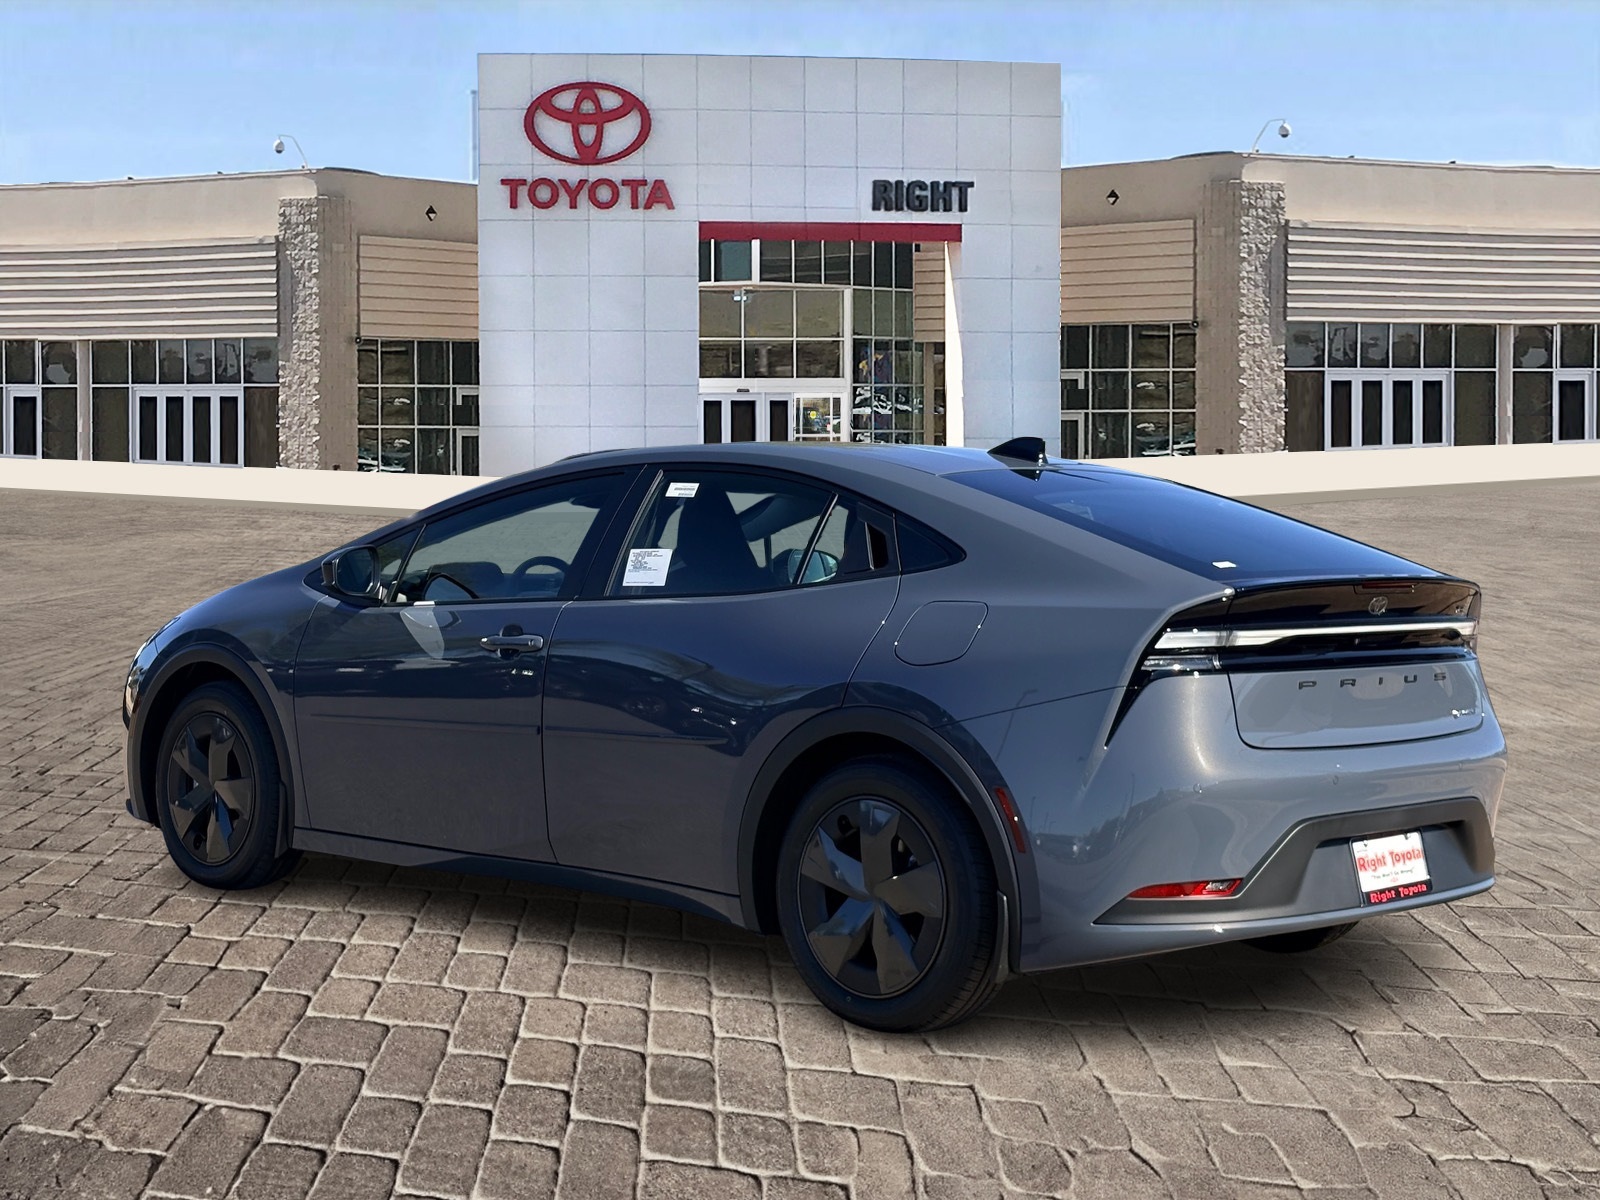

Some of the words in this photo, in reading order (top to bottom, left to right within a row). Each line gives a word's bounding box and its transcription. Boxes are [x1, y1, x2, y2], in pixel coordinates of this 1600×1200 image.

[500, 177, 675, 210] TOYOTA
[872, 179, 975, 212] RIGHT
[1298, 672, 1447, 690] PRIUS
[1357, 853, 1387, 872] Right
[1388, 847, 1422, 867] Toyota
[1370, 889, 1396, 903] Right
[1399, 883, 1427, 897] Toyota
